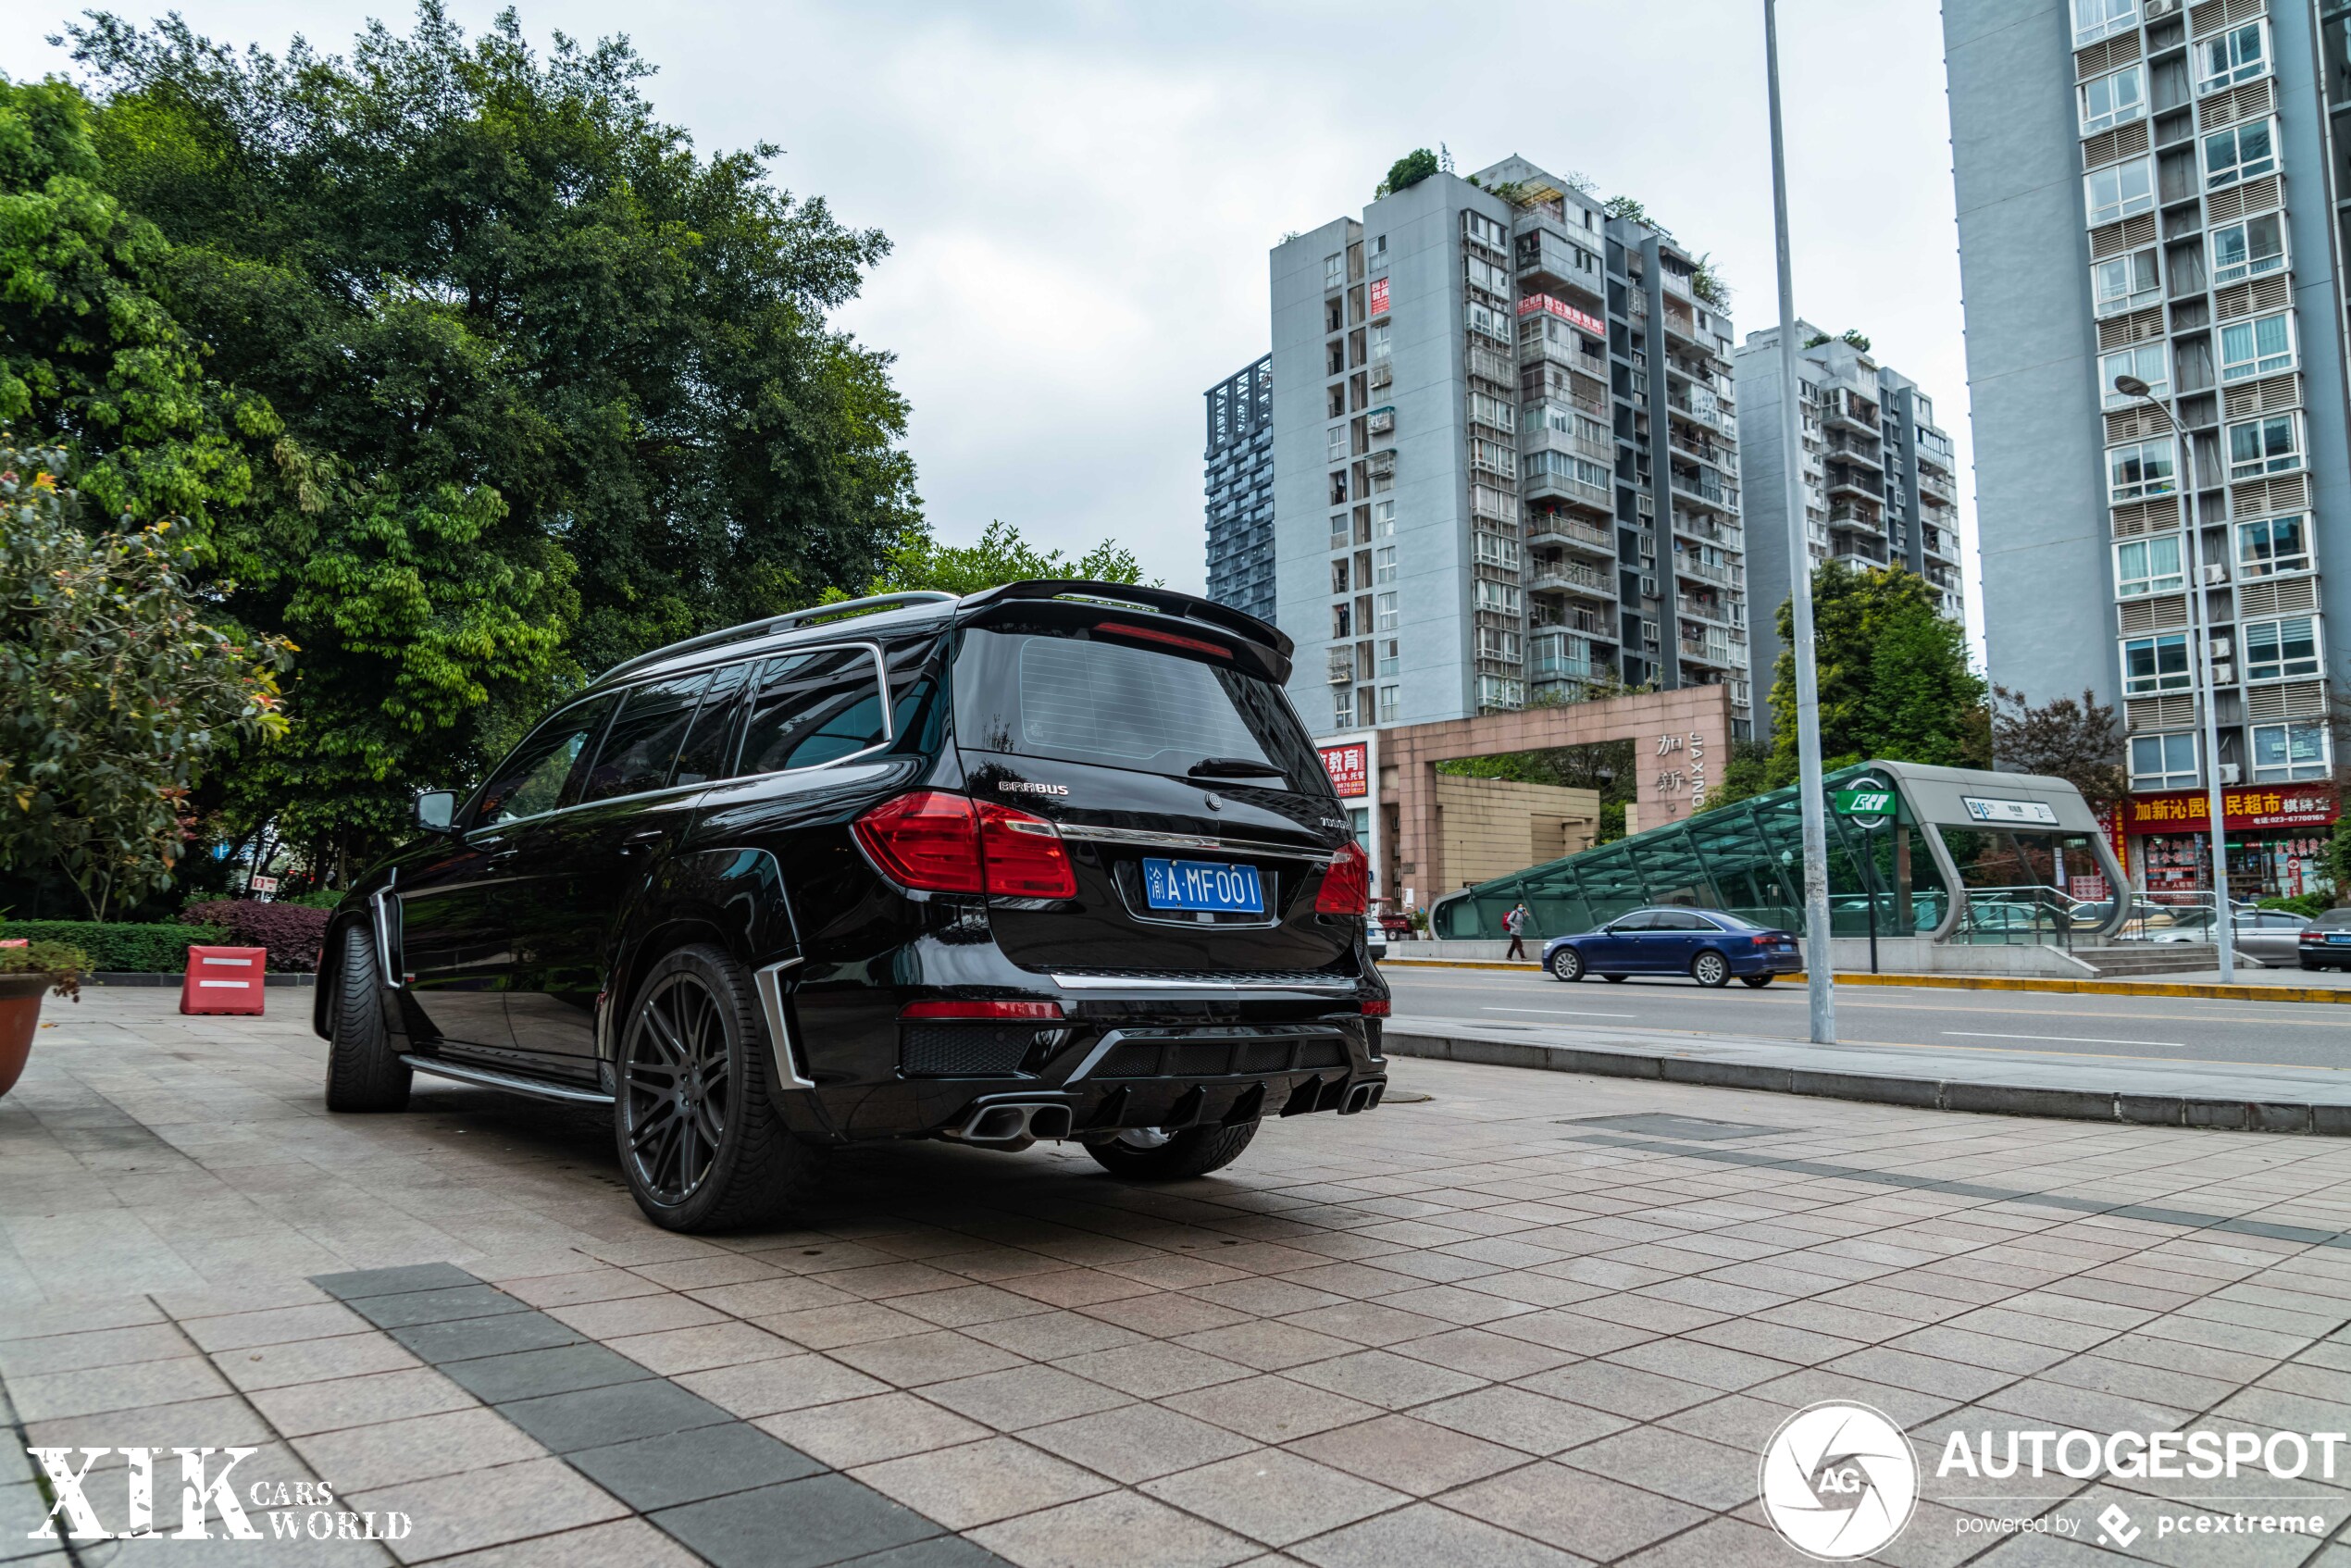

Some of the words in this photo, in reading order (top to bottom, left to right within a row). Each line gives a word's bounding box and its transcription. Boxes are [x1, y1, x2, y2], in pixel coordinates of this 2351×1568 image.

[1656, 735, 1686, 792] 加新
[1689, 731, 1705, 808] JIAXING
[999, 780, 1069, 796] BRABUS
[2134, 792, 2281, 822] 加新沁园民超市
